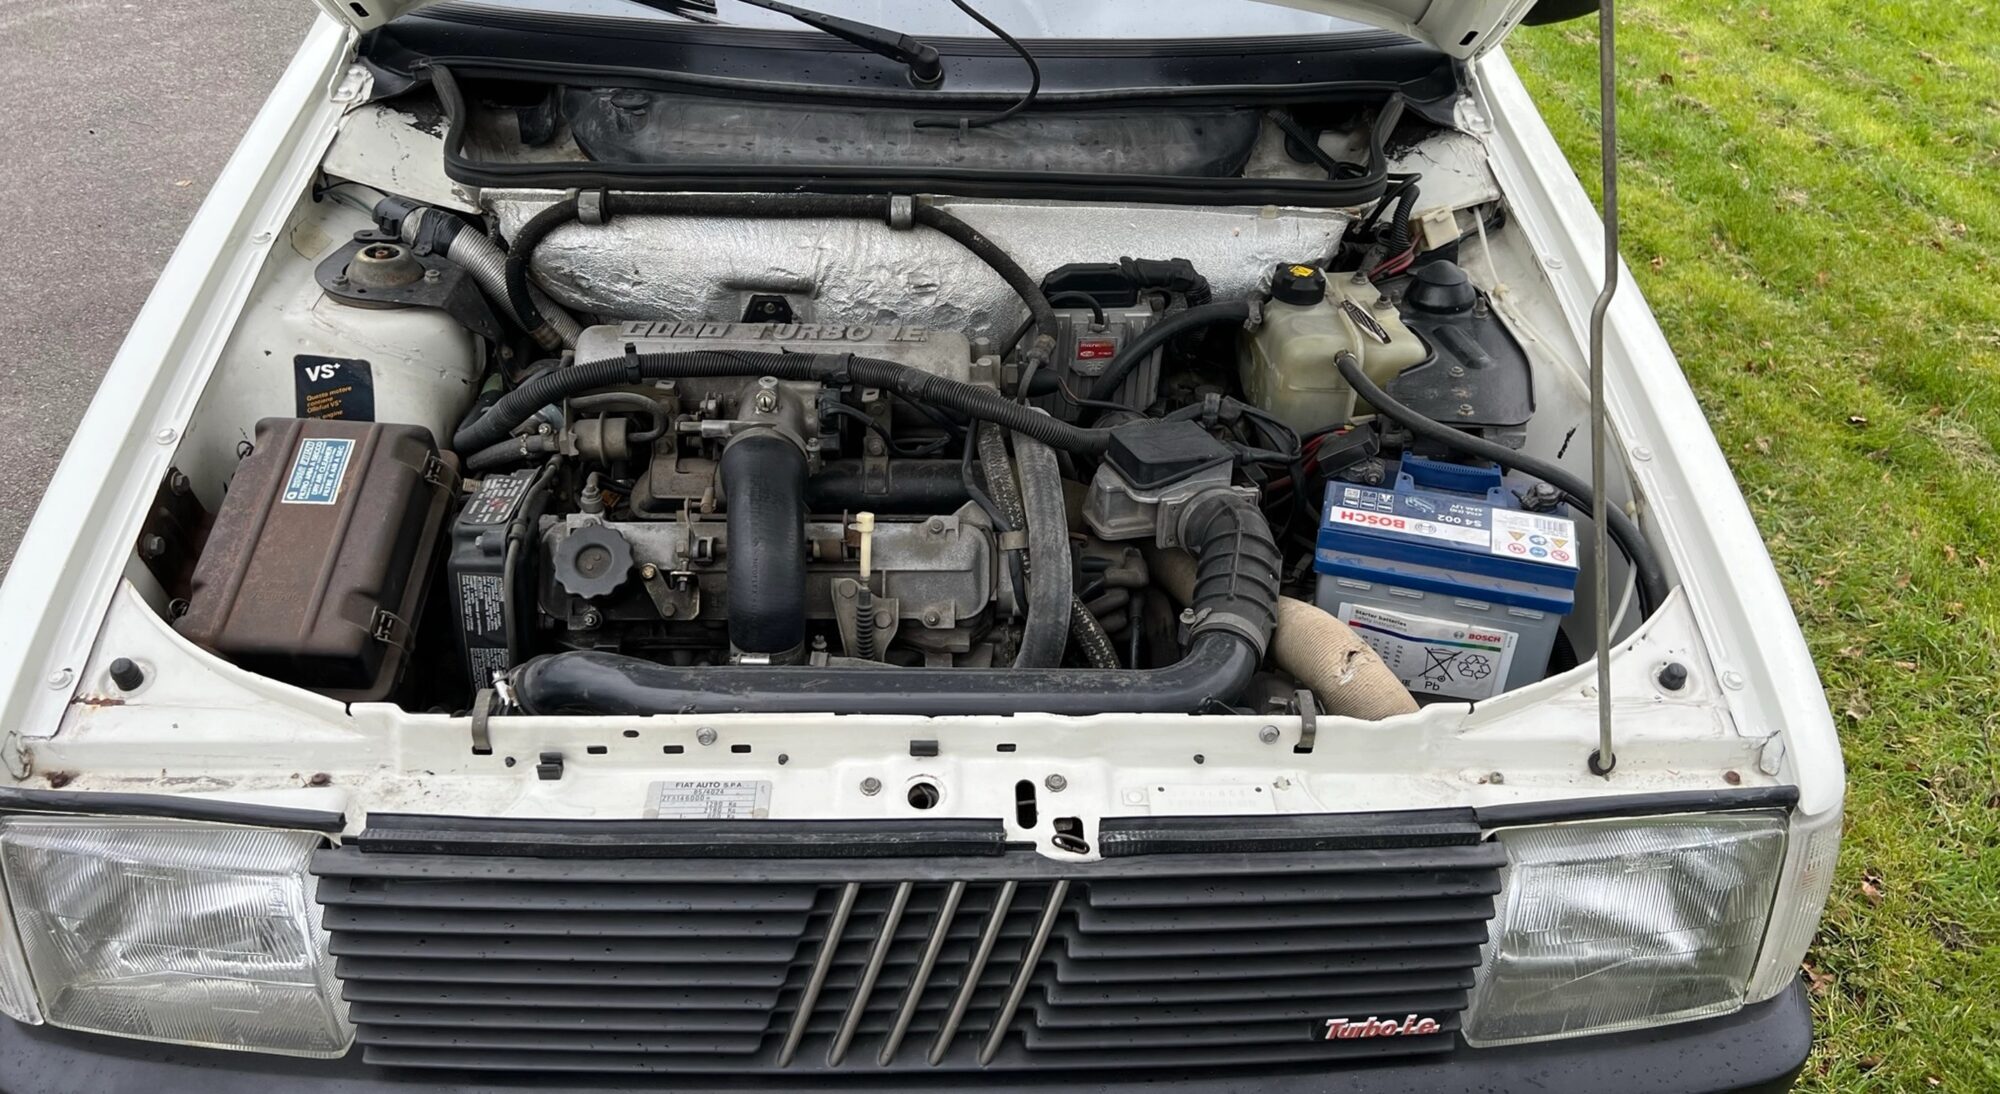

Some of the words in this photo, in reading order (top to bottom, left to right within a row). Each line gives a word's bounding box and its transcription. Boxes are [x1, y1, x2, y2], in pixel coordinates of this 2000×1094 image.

[626, 322, 729, 338] FIAT
[752, 323, 873, 342] TURBO
[1340, 510, 1405, 530] BOSCH
[1437, 513, 1462, 524] 002
[1465, 518, 1483, 528] S4
[1354, 614, 1372, 623] Safety
[1355, 609, 1377, 619] Starter
[1379, 615, 1407, 627] batteries
[1468, 633, 1502, 643] BOSCH
[1424, 680, 1440, 691] Pb
[1325, 1016, 1399, 1040] Turbo
